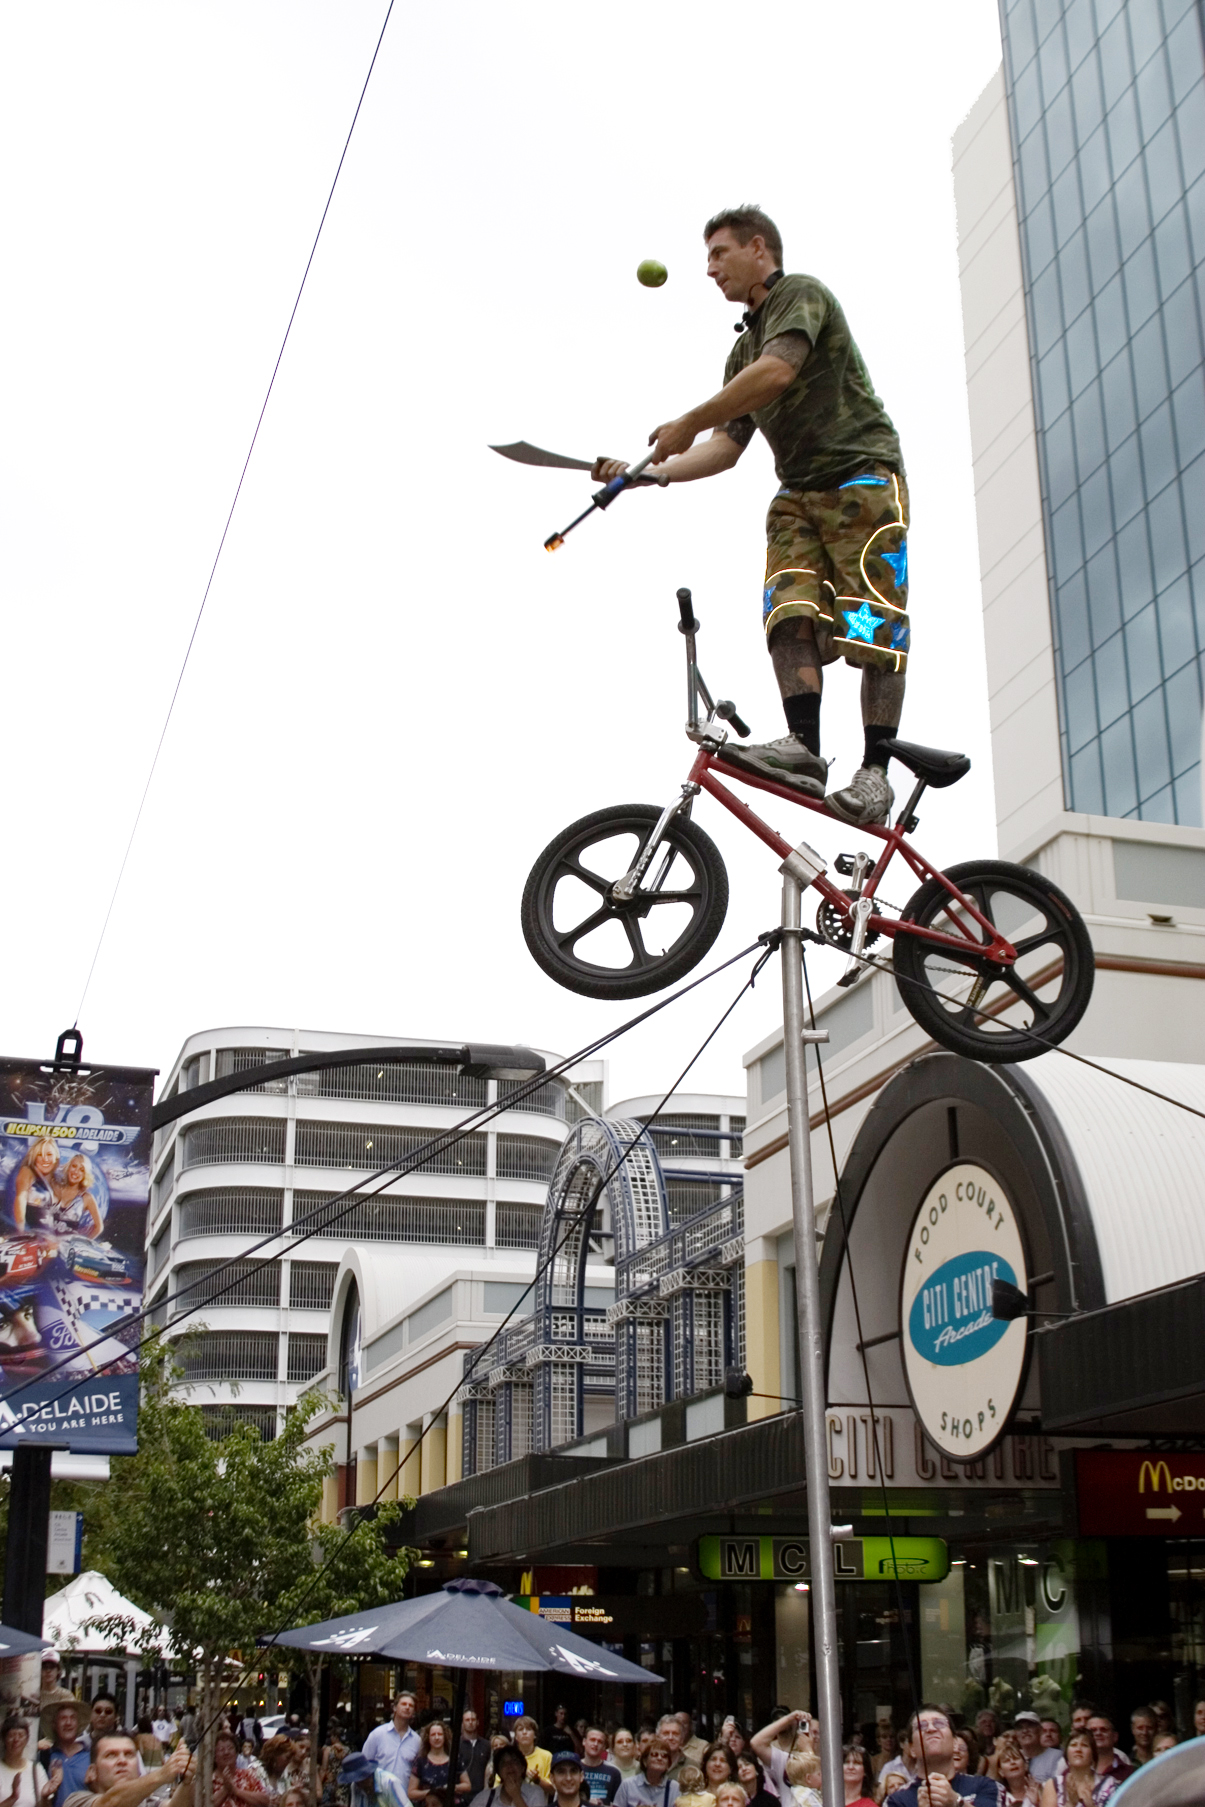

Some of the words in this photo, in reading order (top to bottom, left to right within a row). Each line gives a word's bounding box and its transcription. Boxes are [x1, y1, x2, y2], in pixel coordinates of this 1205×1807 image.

[15, 1123, 52, 1137] CLIPSAL
[51, 1126, 77, 1139] 500
[76, 1128, 119, 1141] ADELAIDE
[914, 1193, 948, 1264] FOOD
[955, 1181, 1004, 1231] COURT
[922, 1283, 949, 1330] CITI
[933, 1311, 994, 1353] Arcade
[29, 1421, 57, 1433] YOU
[61, 1416, 87, 1430] ARE
[91, 1413, 125, 1427] HERE
[940, 1398, 996, 1439] SHOPS
[825, 1414, 894, 1479] CITI
[914, 1419, 1057, 1481] CRE
[539, 1607, 571, 1615] AMERICAN
[544, 1614, 572, 1623] EXPRESS
[574, 1614, 614, 1625] Exchange
[575, 1606, 606, 1616] Foreign
[581, 1771, 612, 1783] ZENGER
